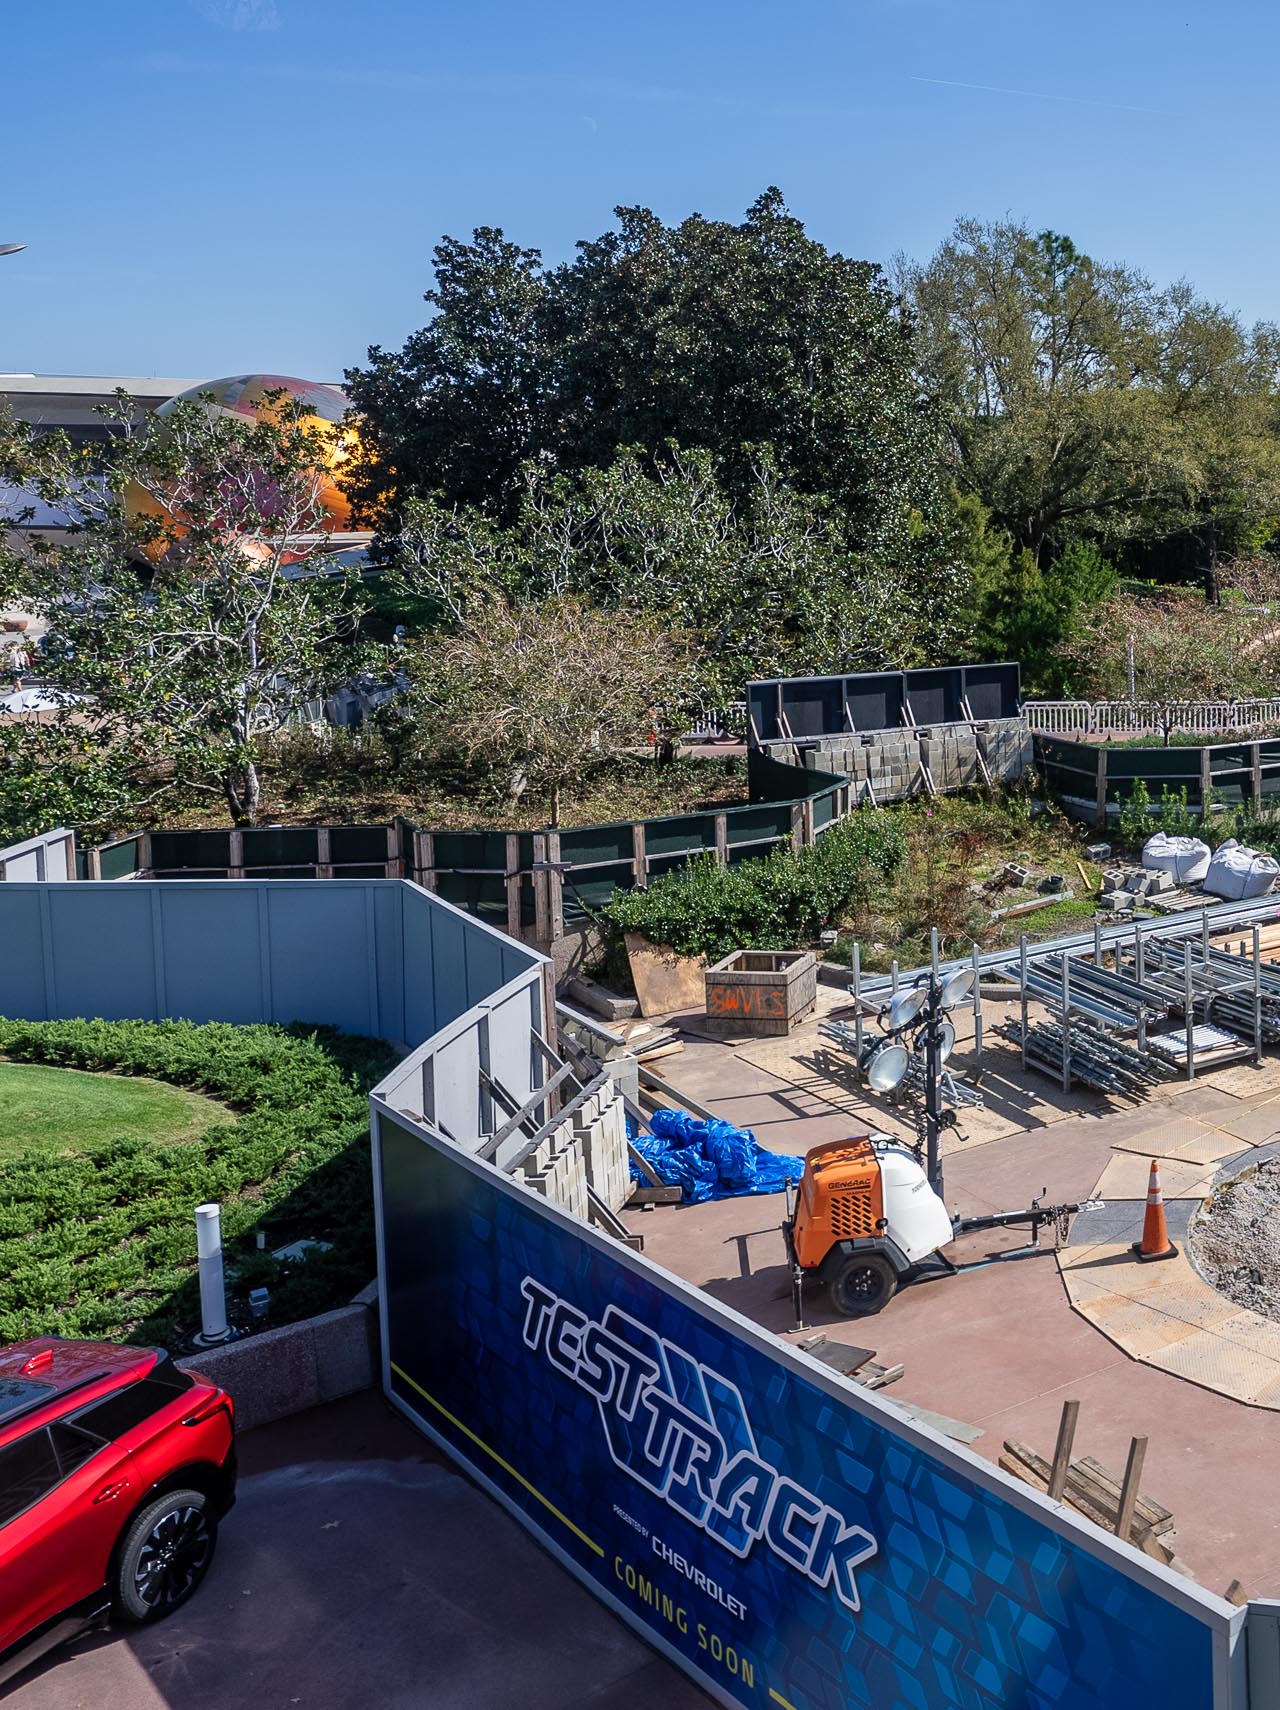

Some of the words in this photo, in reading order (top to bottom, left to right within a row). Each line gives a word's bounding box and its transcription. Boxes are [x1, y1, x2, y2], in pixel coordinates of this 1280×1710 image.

[828, 1178, 871, 1189] GENERAC
[520, 1275, 661, 1423] TEST
[613, 1504, 642, 1533] PRESENTED
[652, 1535, 748, 1622] CHEVROLET
[641, 1384, 878, 1613] TRACK
[615, 1556, 688, 1634] COMING
[697, 1623, 754, 1689] SOON
